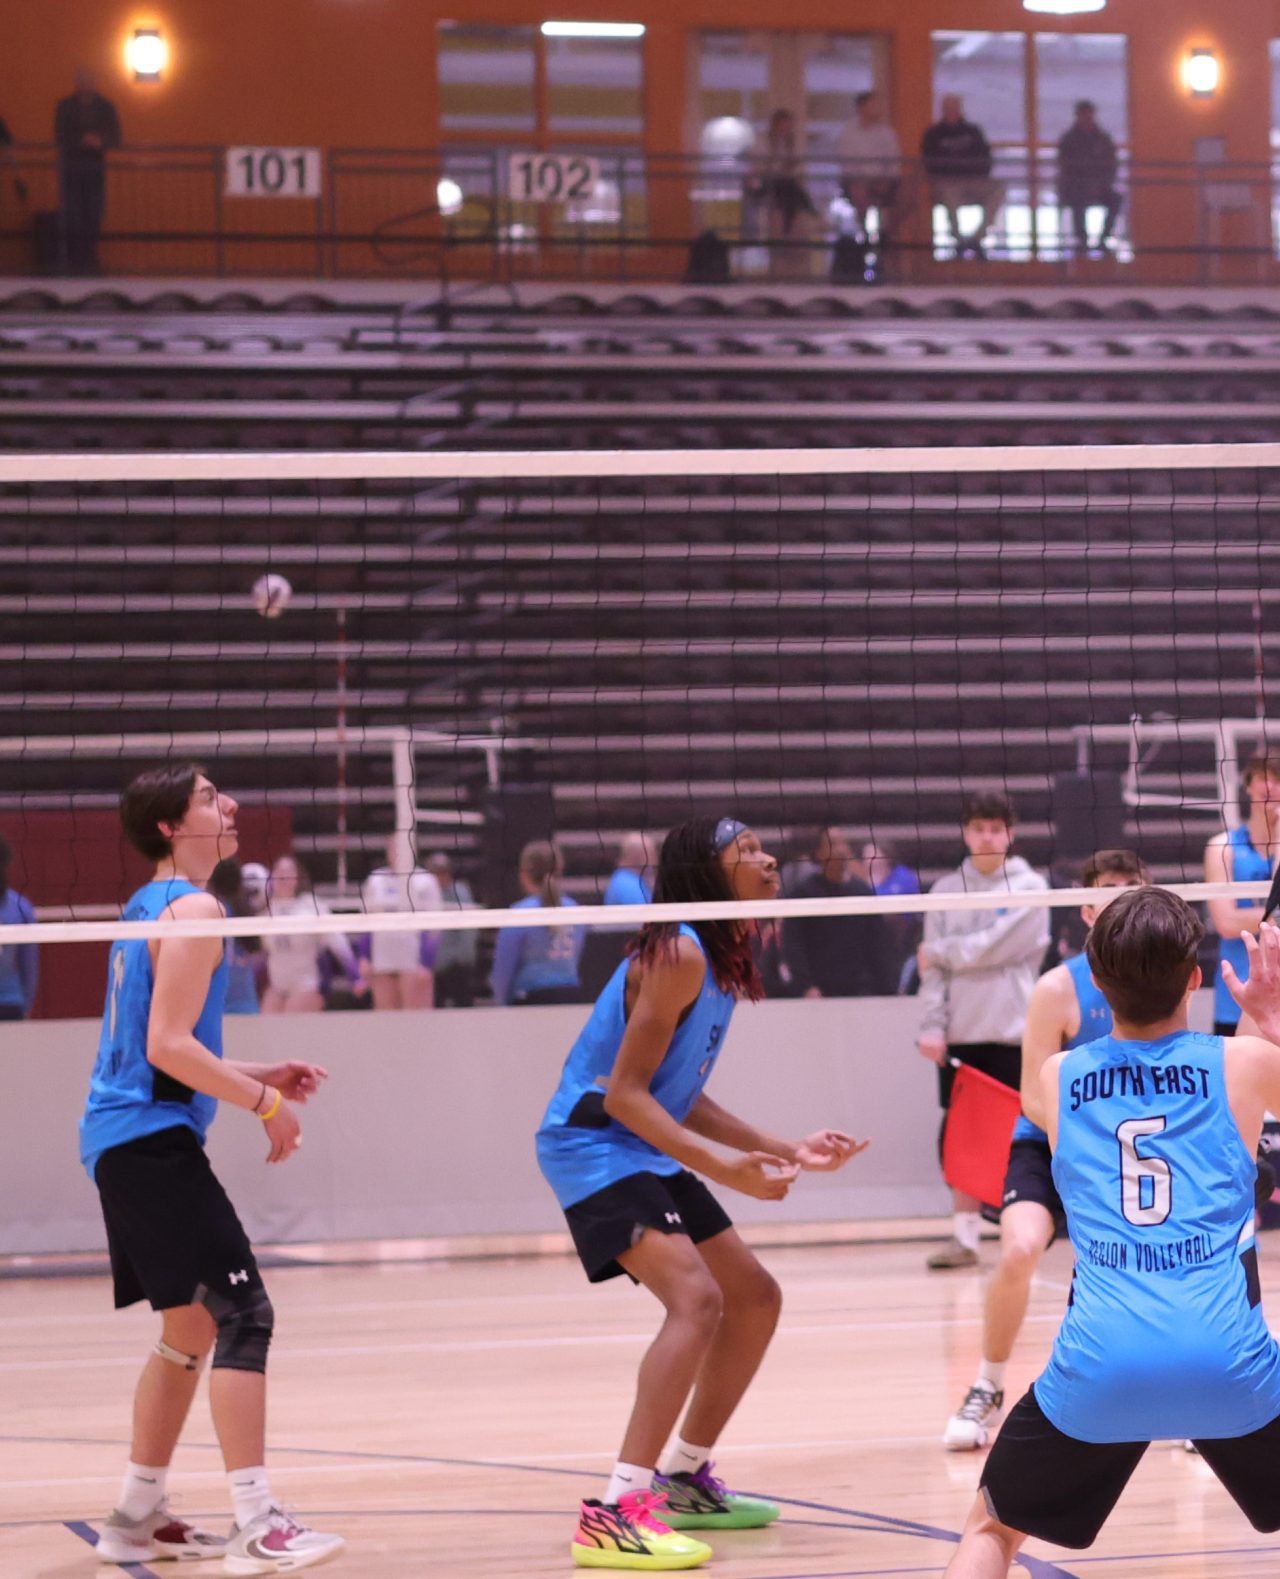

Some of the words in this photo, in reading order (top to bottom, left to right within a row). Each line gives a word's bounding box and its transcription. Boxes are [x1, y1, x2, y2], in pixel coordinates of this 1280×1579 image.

[237, 153, 305, 192] 101
[518, 160, 593, 199] 102
[1070, 1065, 1145, 1111] SOUTH
[1152, 1065, 1209, 1099] EAST
[1115, 1115, 1172, 1227] 6
[1089, 1240, 1127, 1270] REGION
[1135, 1232, 1214, 1273] VOLLEYBALL
